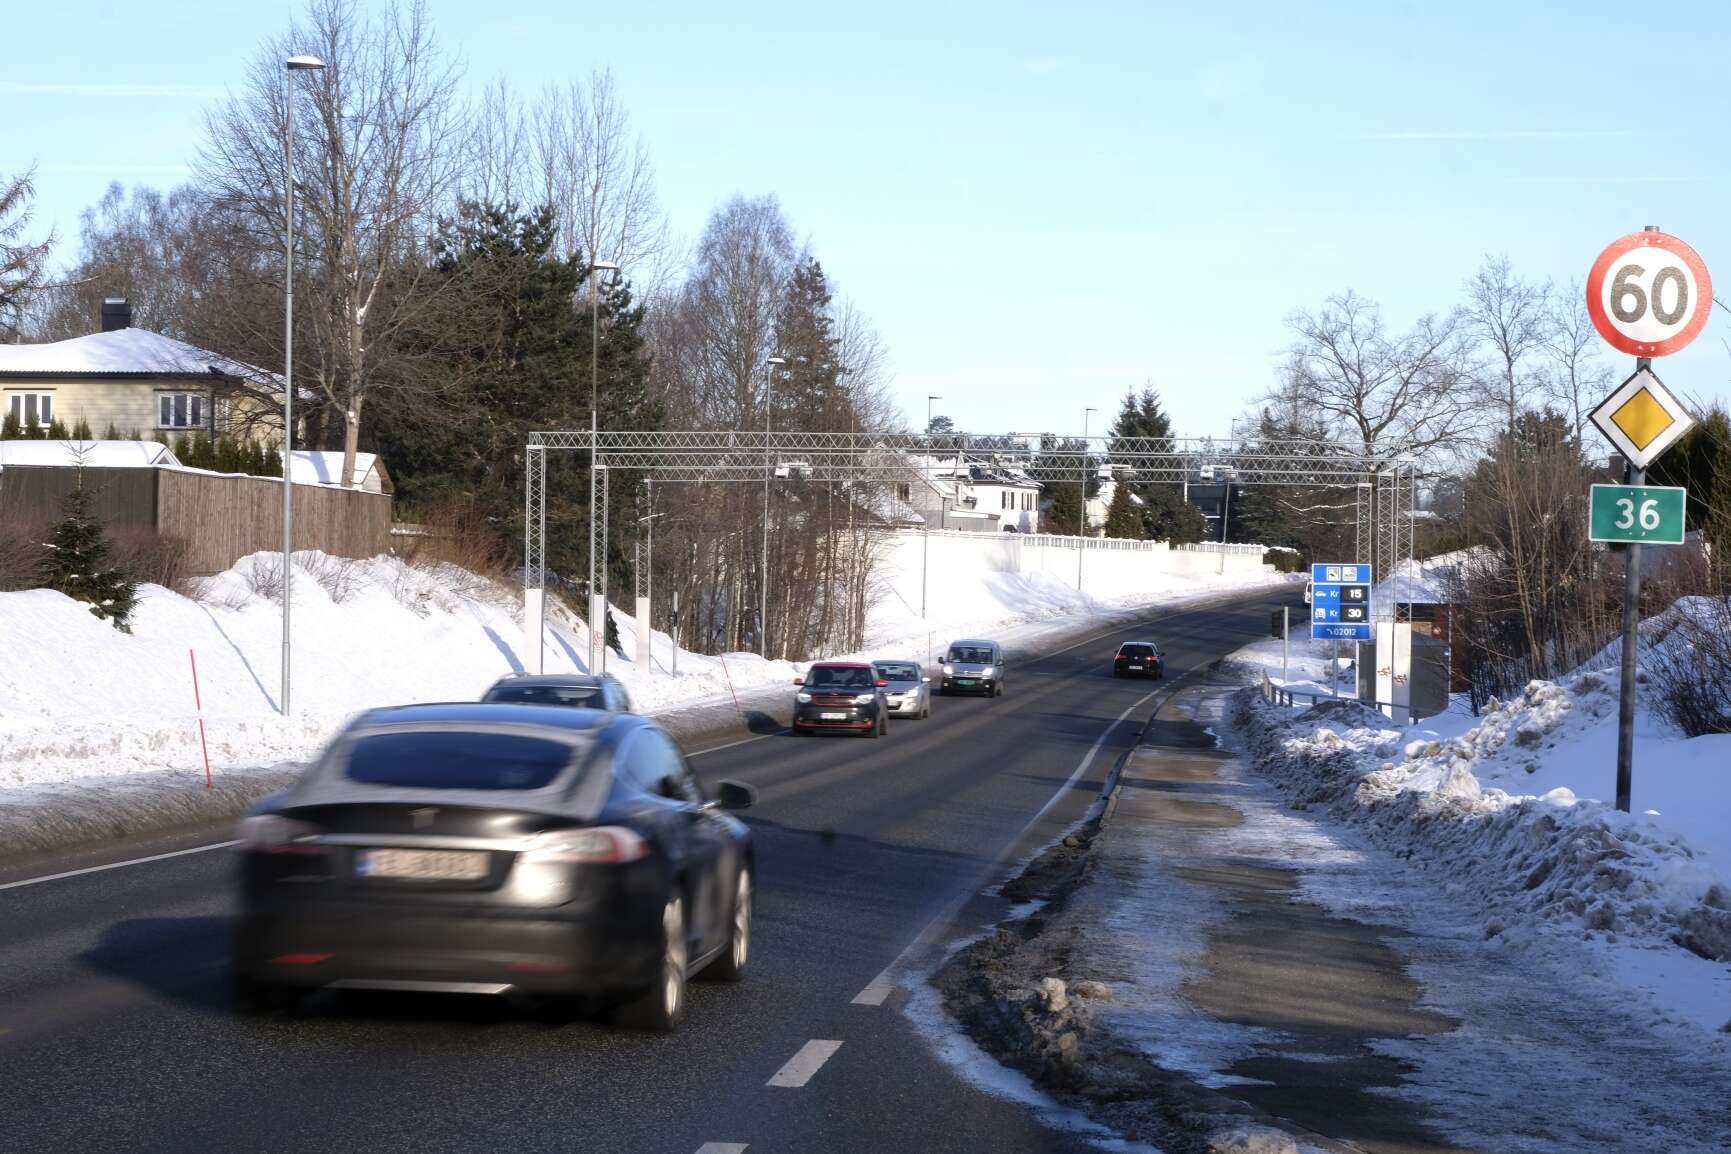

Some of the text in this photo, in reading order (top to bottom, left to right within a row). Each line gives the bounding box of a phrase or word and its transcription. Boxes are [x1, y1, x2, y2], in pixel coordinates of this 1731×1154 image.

[1610, 264, 1688, 325] 60
[1615, 498, 1660, 530] 36
[1330, 589, 1362, 598] Kr 15
[1348, 608, 1362, 618] 30
[1333, 628, 1357, 636] 02012
